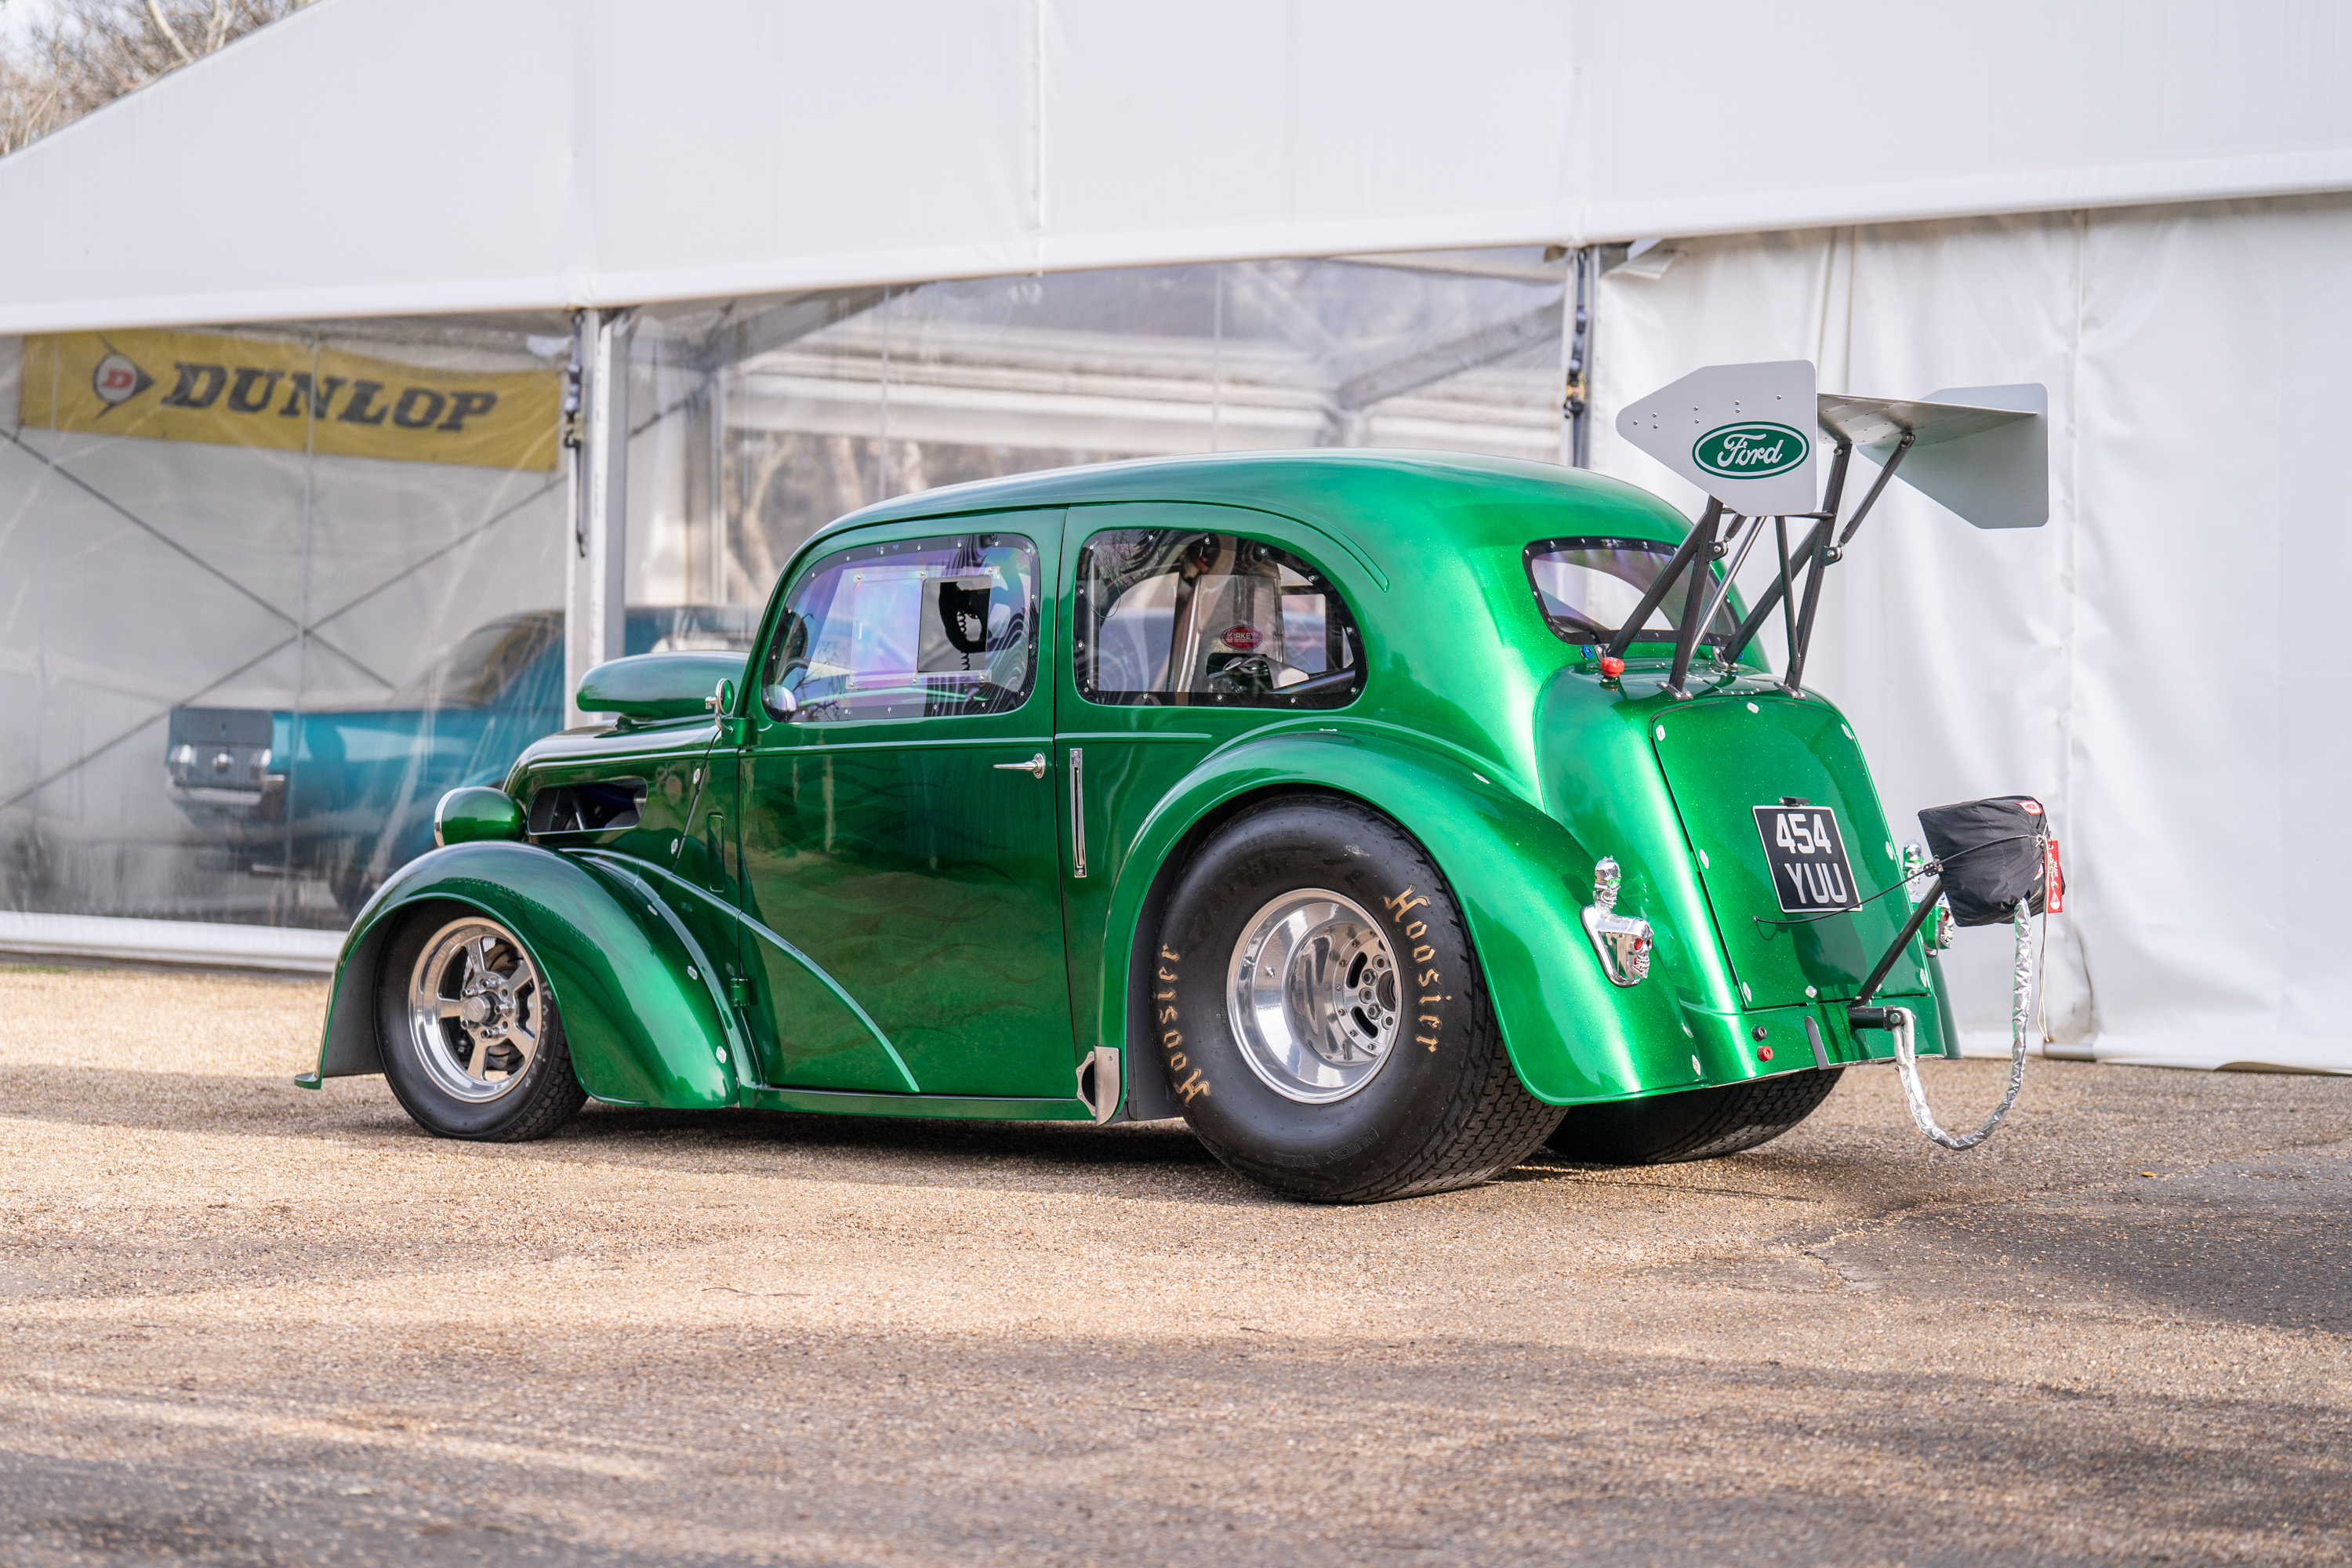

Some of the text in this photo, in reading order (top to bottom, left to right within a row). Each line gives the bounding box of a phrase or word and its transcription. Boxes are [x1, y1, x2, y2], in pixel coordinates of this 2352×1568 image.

[100, 368, 134, 390] D
[161, 362, 498, 431] DUNLOP
[1717, 434, 1784, 467] Ford
[1776, 813, 1832, 854] 454
[1784, 863, 1848, 903] YUU
[1382, 884, 1453, 1053] Hoosier
[1158, 943, 1211, 1108] Hoosier
